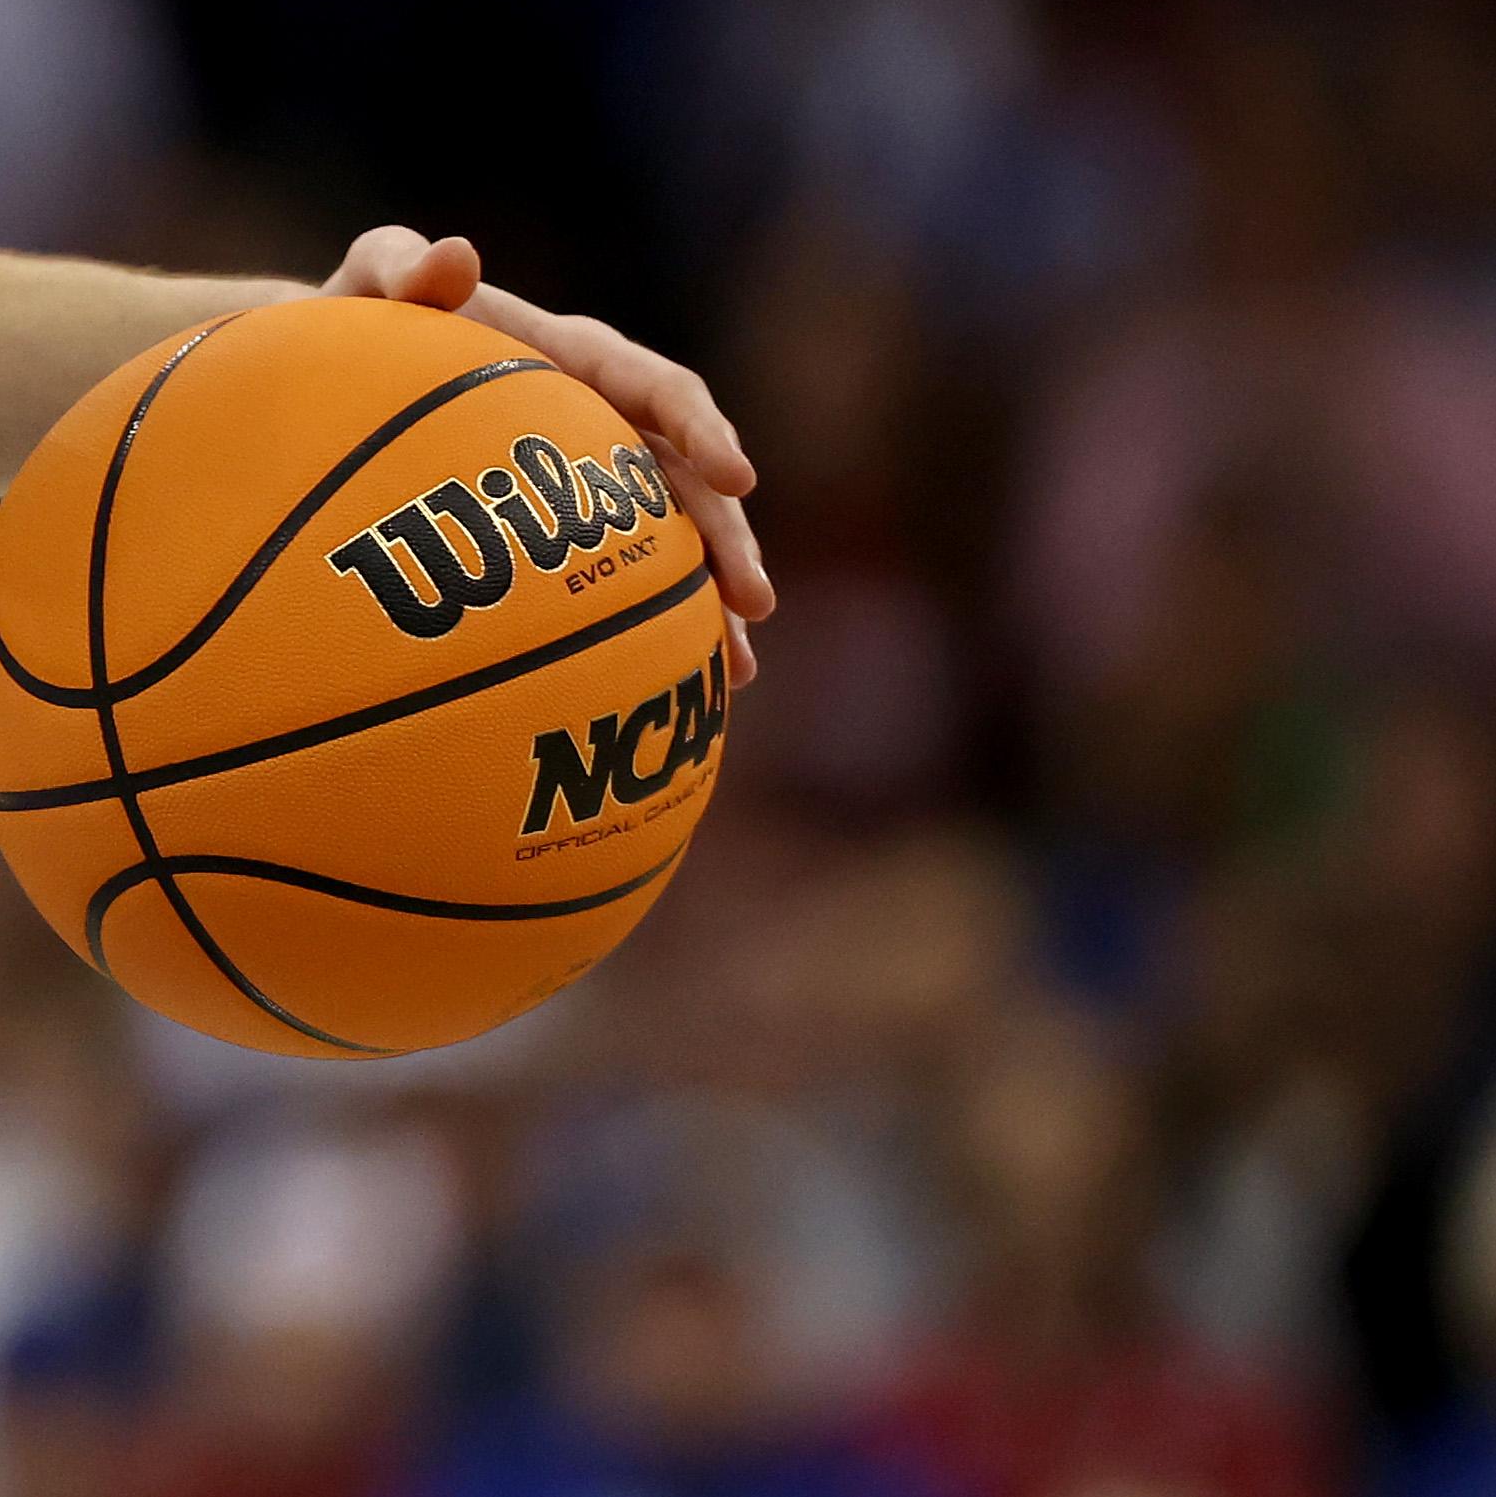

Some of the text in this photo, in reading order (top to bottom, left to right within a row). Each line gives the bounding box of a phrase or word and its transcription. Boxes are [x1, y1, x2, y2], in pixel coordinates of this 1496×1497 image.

[323, 433, 683, 641] Wilso
[565, 535, 657, 595] EVO NXT
[515, 821, 638, 862] OFFICIAL
